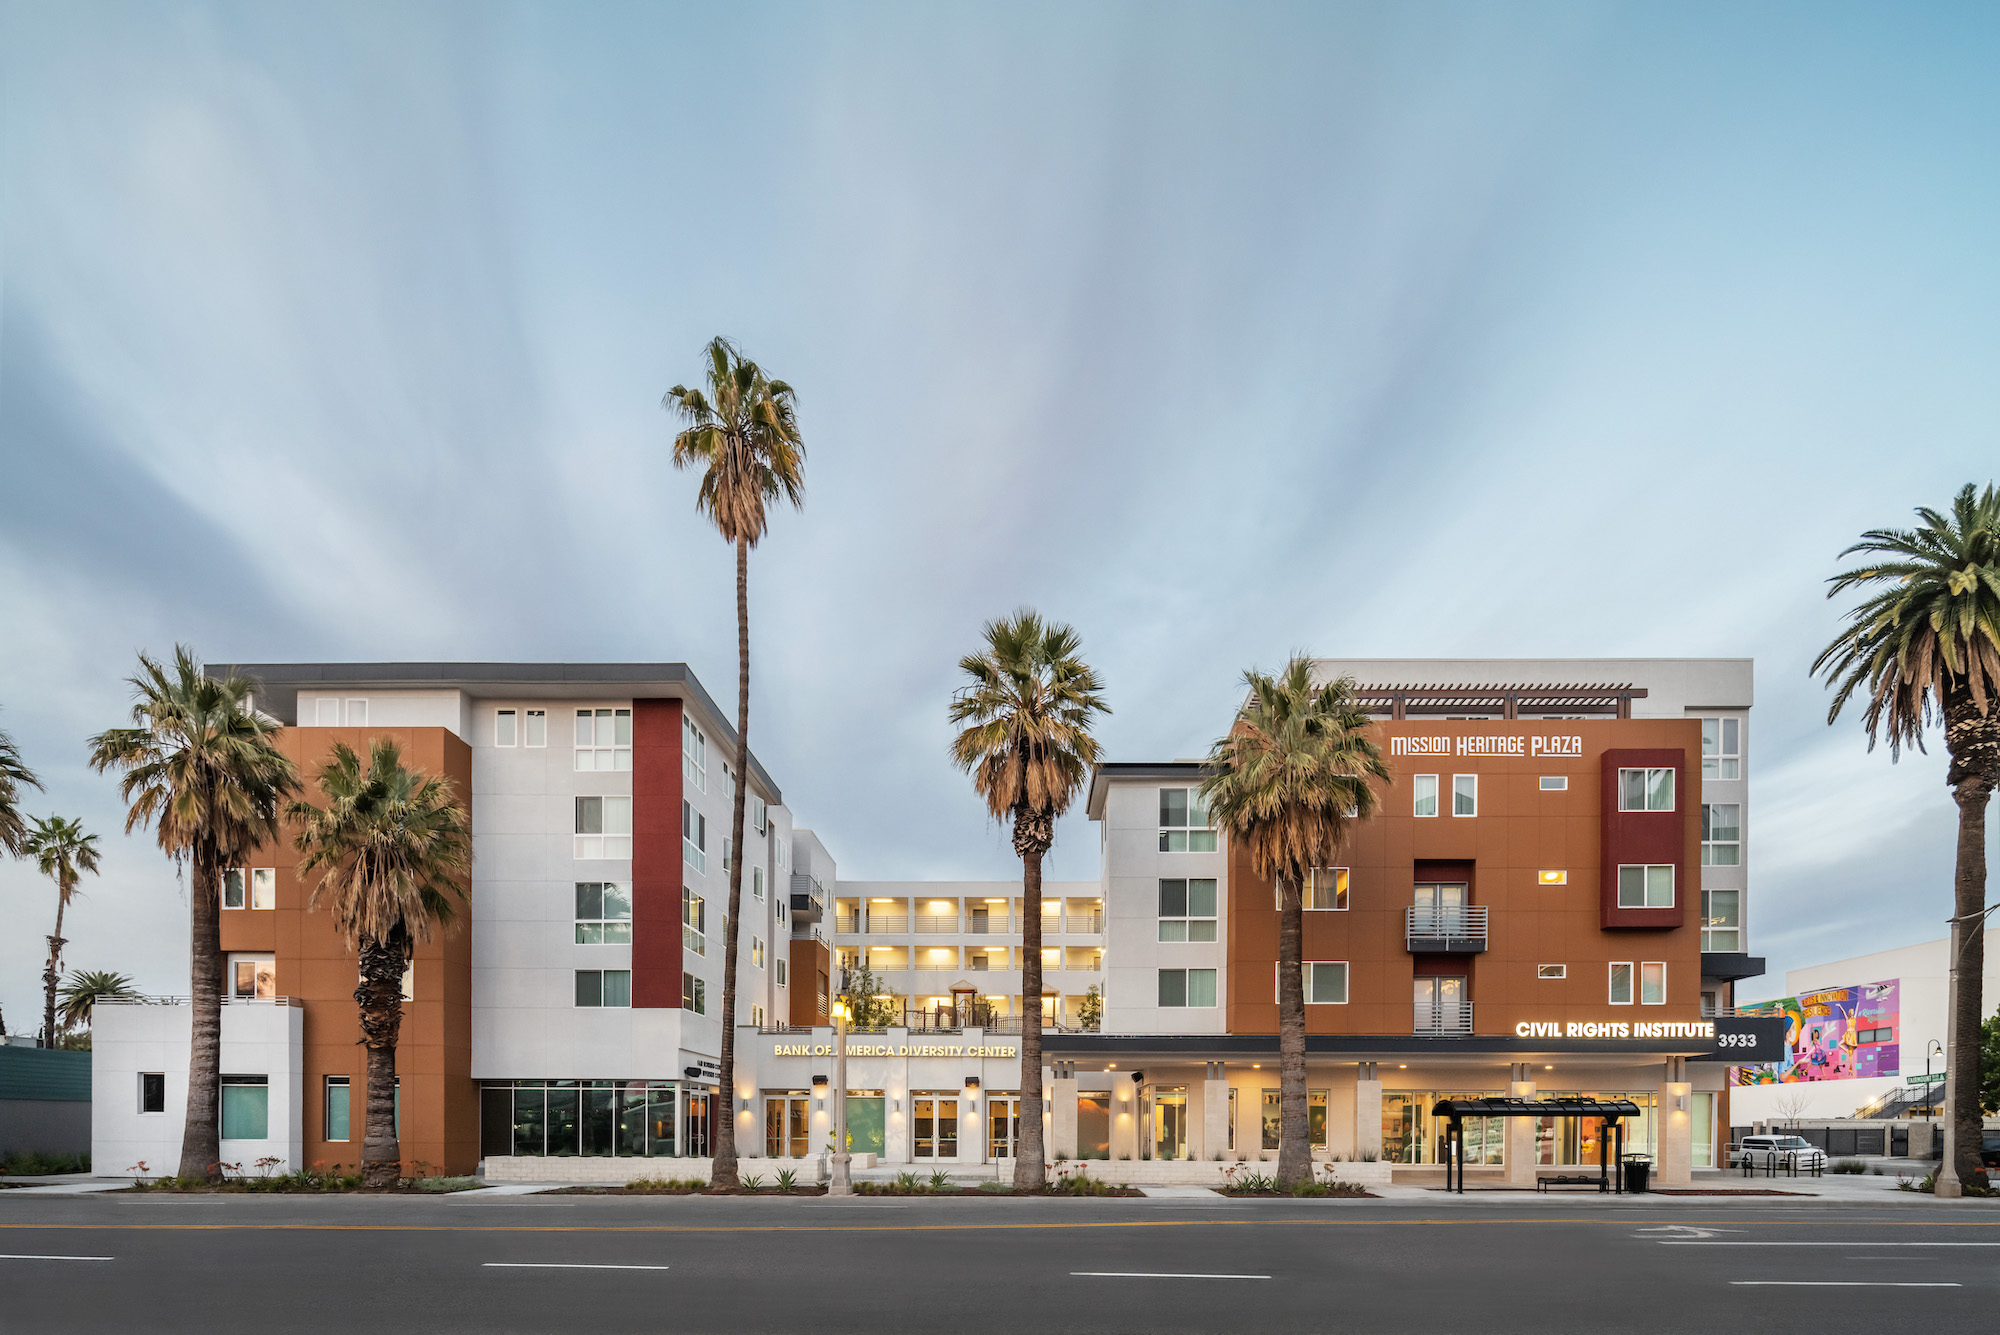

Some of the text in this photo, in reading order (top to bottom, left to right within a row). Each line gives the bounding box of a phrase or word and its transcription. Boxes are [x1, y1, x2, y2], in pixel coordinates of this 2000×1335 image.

[1391, 736, 1582, 758] MISSION HERITAGE PLAZA
[1515, 1022, 1714, 1038] CIVIL RIGHTS INSTITUTE
[1718, 1033, 1757, 1048] 3933
[774, 1044, 1017, 1058] BANK OF MERICA DIVERSITY CENTER
